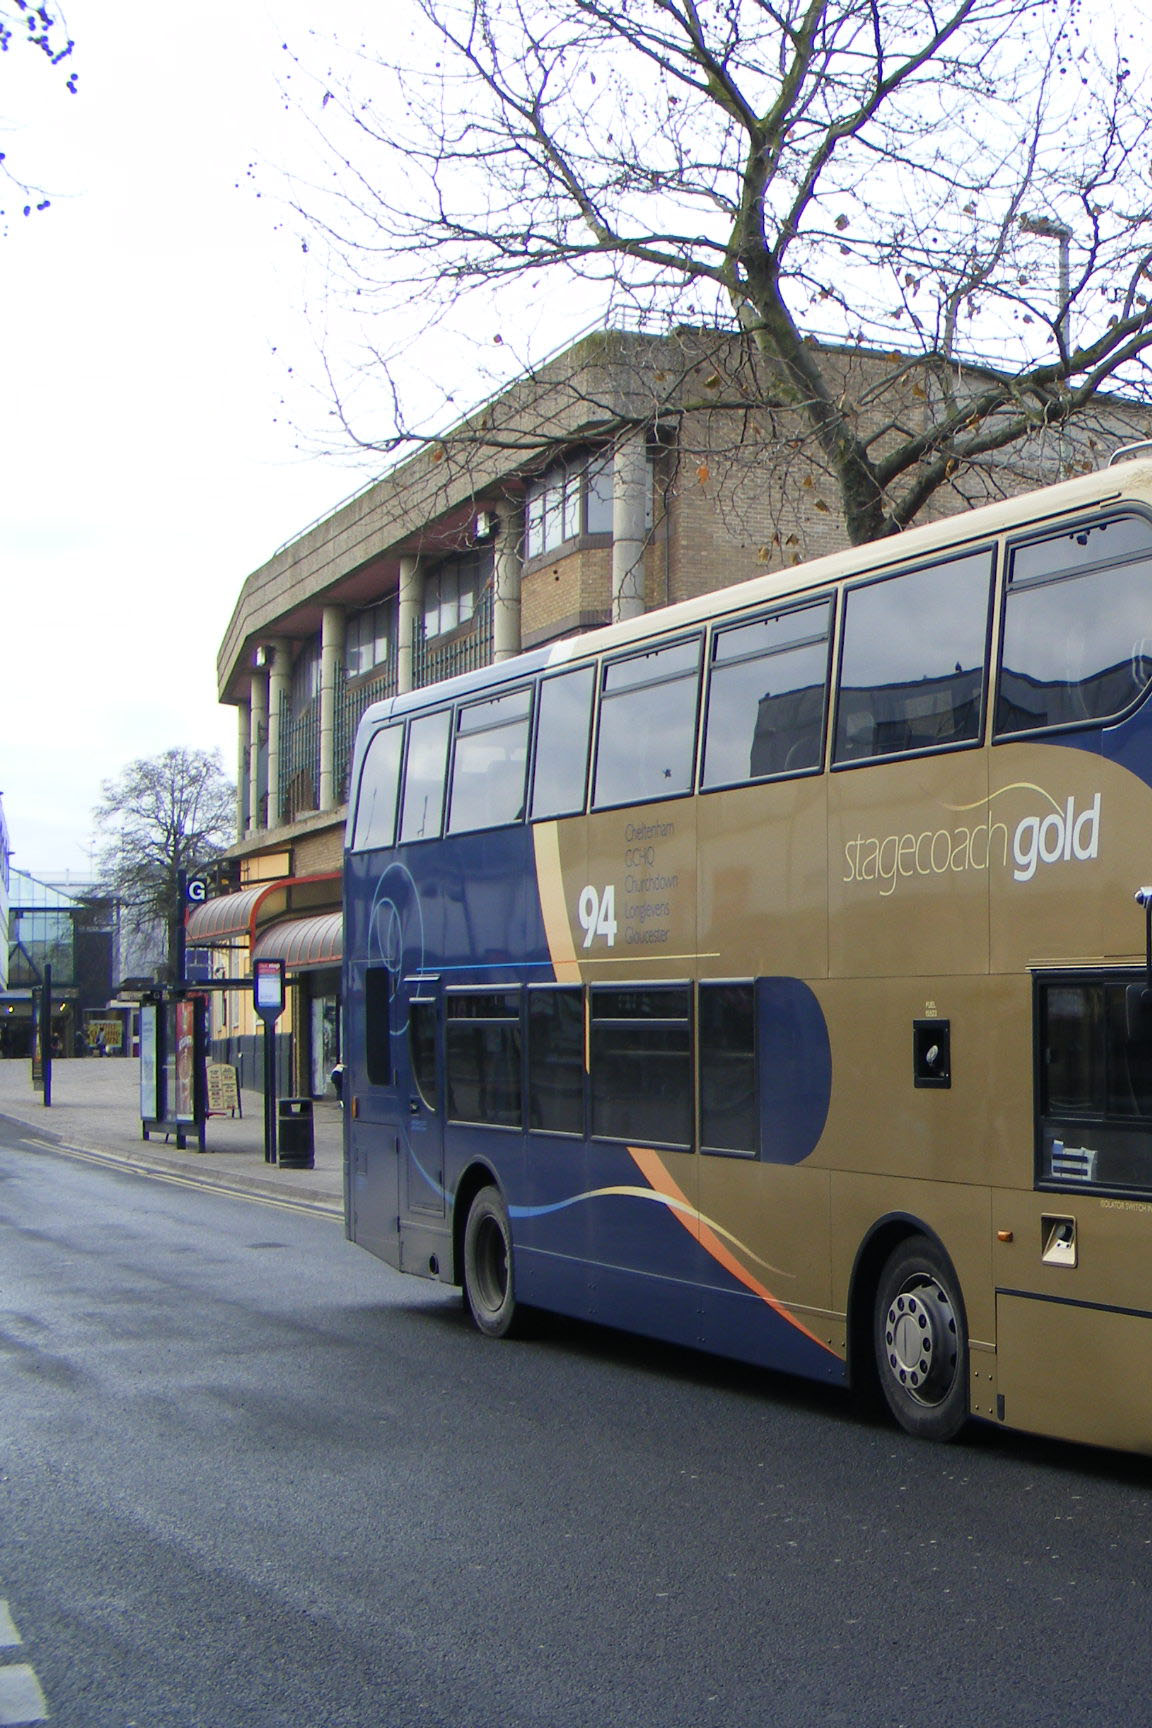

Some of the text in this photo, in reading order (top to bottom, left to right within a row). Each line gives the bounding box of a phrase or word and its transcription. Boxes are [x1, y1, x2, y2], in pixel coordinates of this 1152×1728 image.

[624, 820, 674, 842] Cheltenham
[843, 792, 1101, 896] stagecoach gold
[624, 846, 655, 868] GCHQ
[189, 881, 206, 900] G
[624, 873, 679, 893] Churchdown
[578, 885, 618, 948] 94
[624, 901, 671, 924] Longlevens
[624, 925, 671, 945] Gloucester
